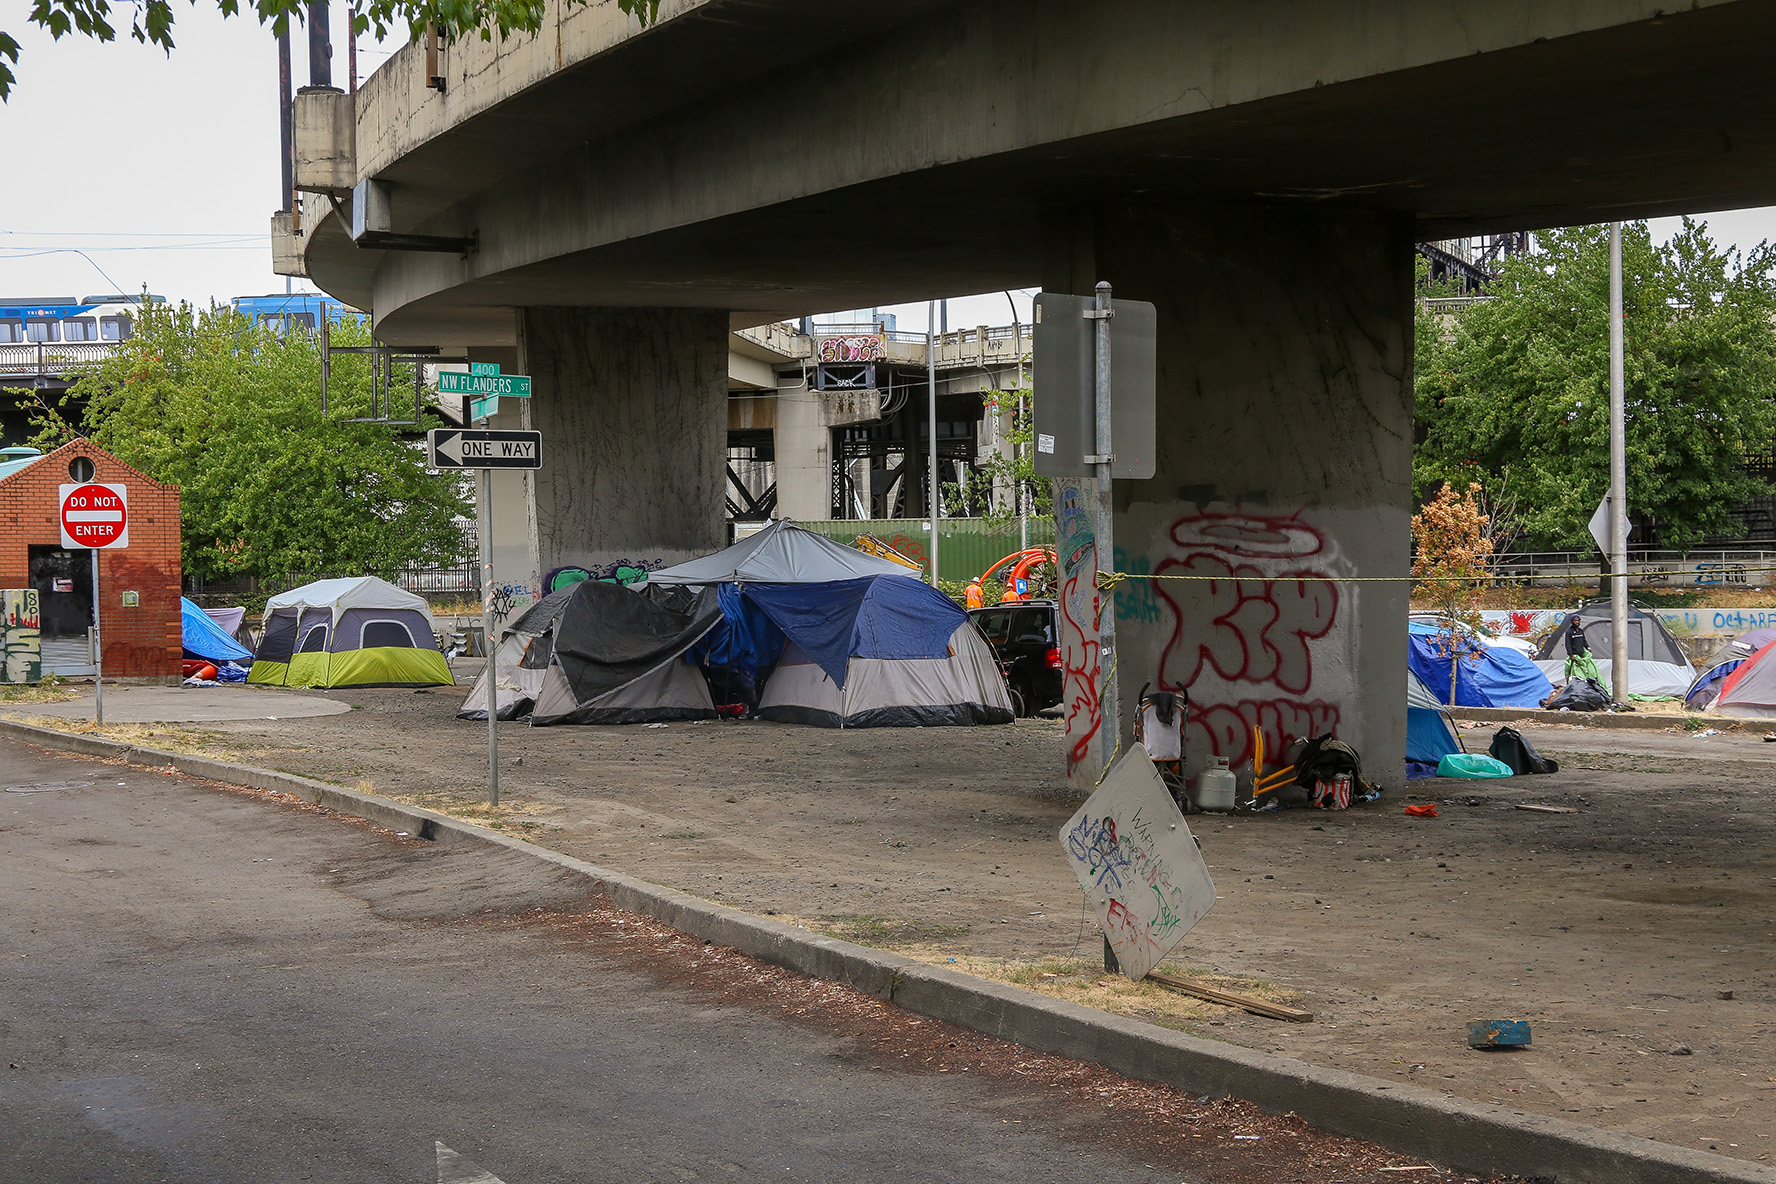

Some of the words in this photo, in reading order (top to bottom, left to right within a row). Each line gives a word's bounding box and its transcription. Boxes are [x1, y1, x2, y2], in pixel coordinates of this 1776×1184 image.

[475, 364, 495, 376] 400
[442, 375, 458, 390] NW
[460, 376, 512, 393] FLANDERS
[520, 382, 529, 391] ST
[462, 441, 493, 456] ONE
[501, 442, 532, 457] WAY
[70, 496, 87, 508] DO
[94, 496, 117, 507] NOT
[75, 525, 114, 536] ENTER
